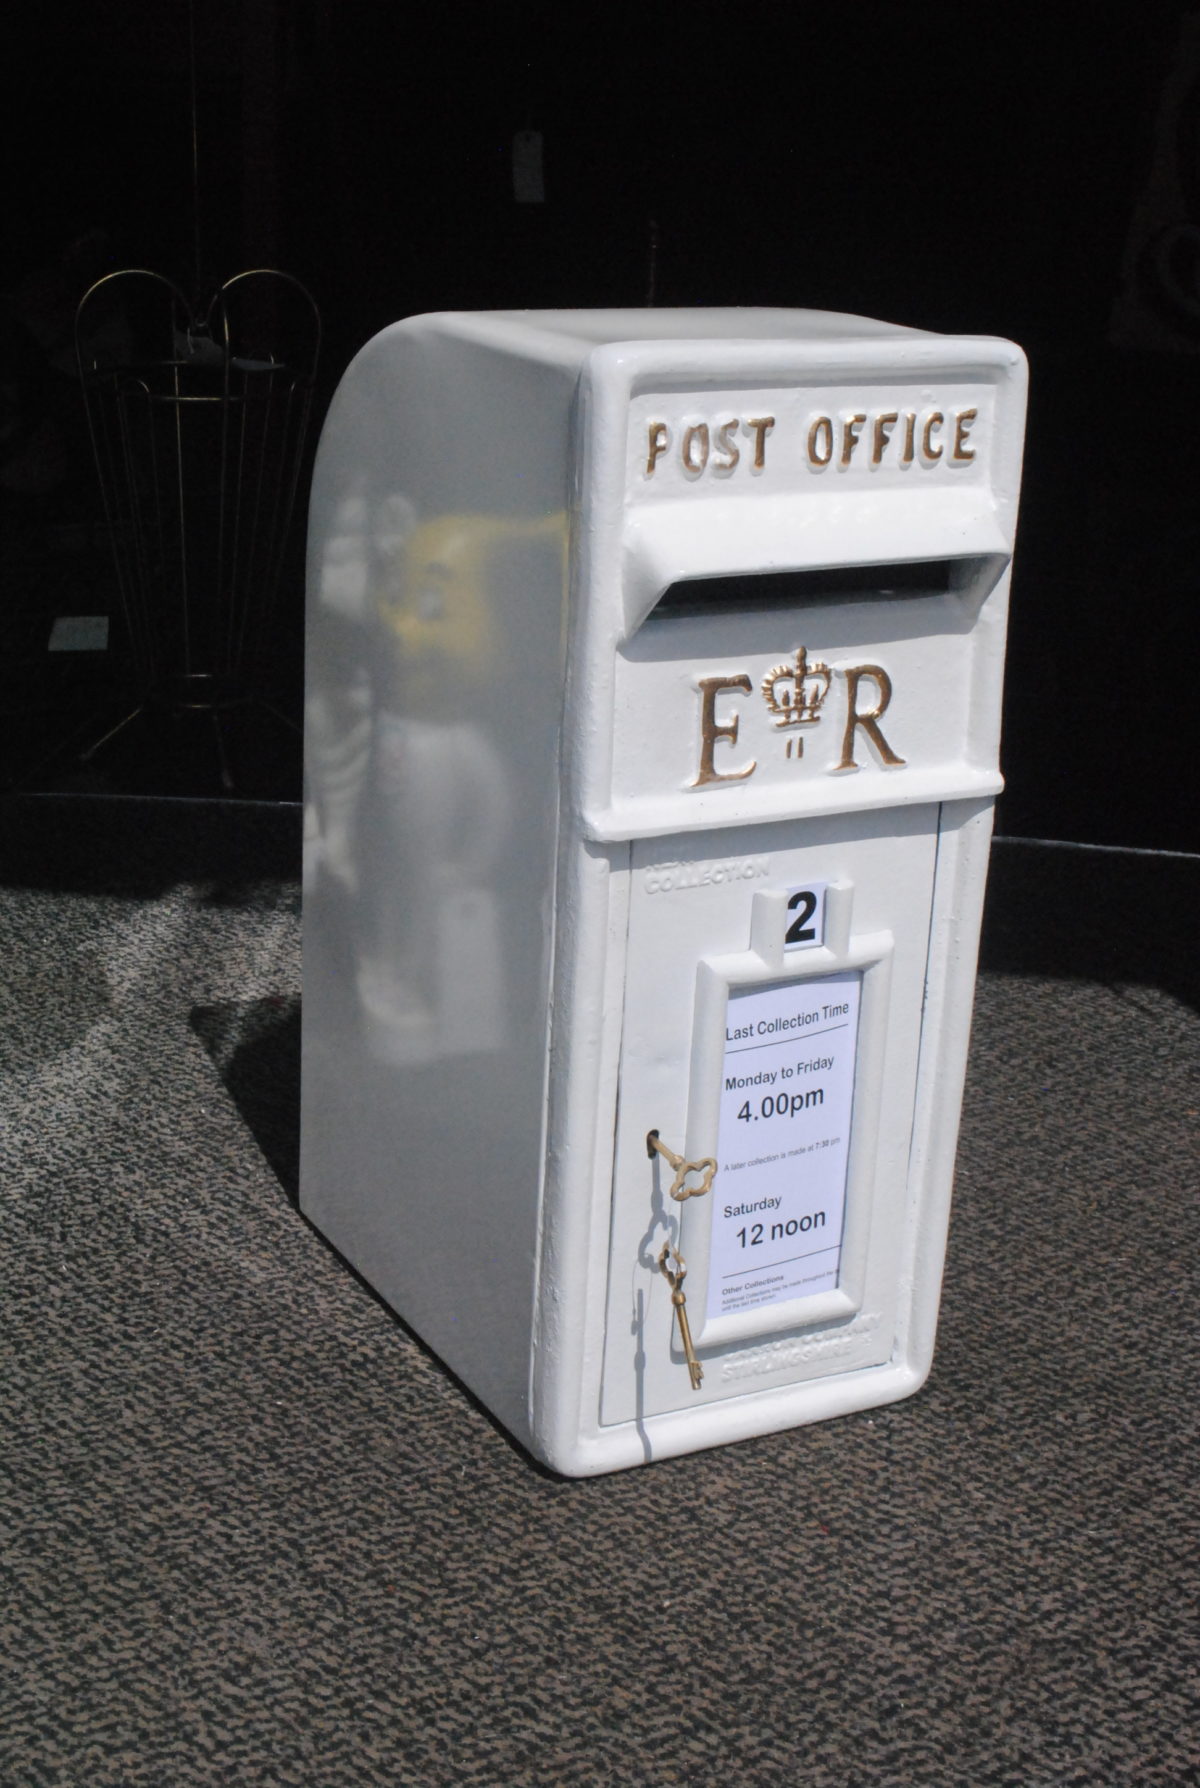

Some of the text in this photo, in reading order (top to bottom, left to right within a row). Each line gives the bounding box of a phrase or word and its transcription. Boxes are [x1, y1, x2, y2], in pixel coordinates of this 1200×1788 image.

[646, 408, 977, 474] POST OFFICE
[691, 664, 906, 787] E R
[644, 856, 770, 894] COLLECTION
[785, 890, 817, 944] 2
[725, 1003, 849, 1041] Last Collection Time
[725, 1056, 835, 1091] Monday to Friday
[737, 1087, 824, 1122] 4.00pm
[724, 1163, 730, 1172] A
[730, 1161, 746, 1171] later
[747, 1154, 779, 1168] collection
[780, 1152, 786, 1160] is
[787, 1146, 806, 1157] made
[807, 1144, 814, 1153] at
[723, 1196, 782, 1218] Saturday
[736, 1211, 826, 1248] 12 noon
[722, 1275, 785, 1296] Other Collections
